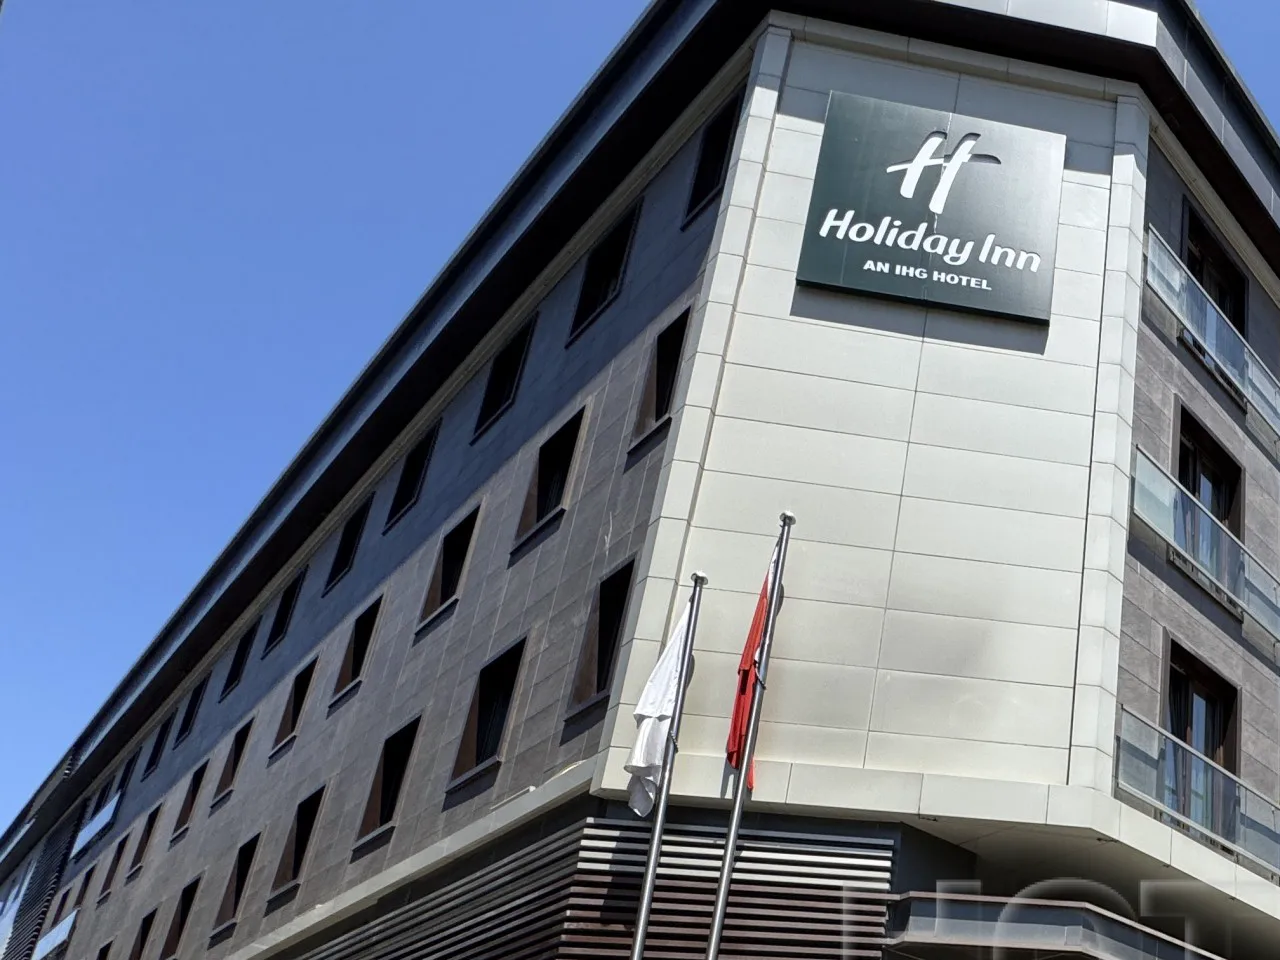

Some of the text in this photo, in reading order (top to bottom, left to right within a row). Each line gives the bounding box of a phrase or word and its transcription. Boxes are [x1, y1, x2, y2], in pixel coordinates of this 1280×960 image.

[819, 208, 1042, 273] Holiday Inn
[863, 259, 993, 291] AN IHG HOTEL
